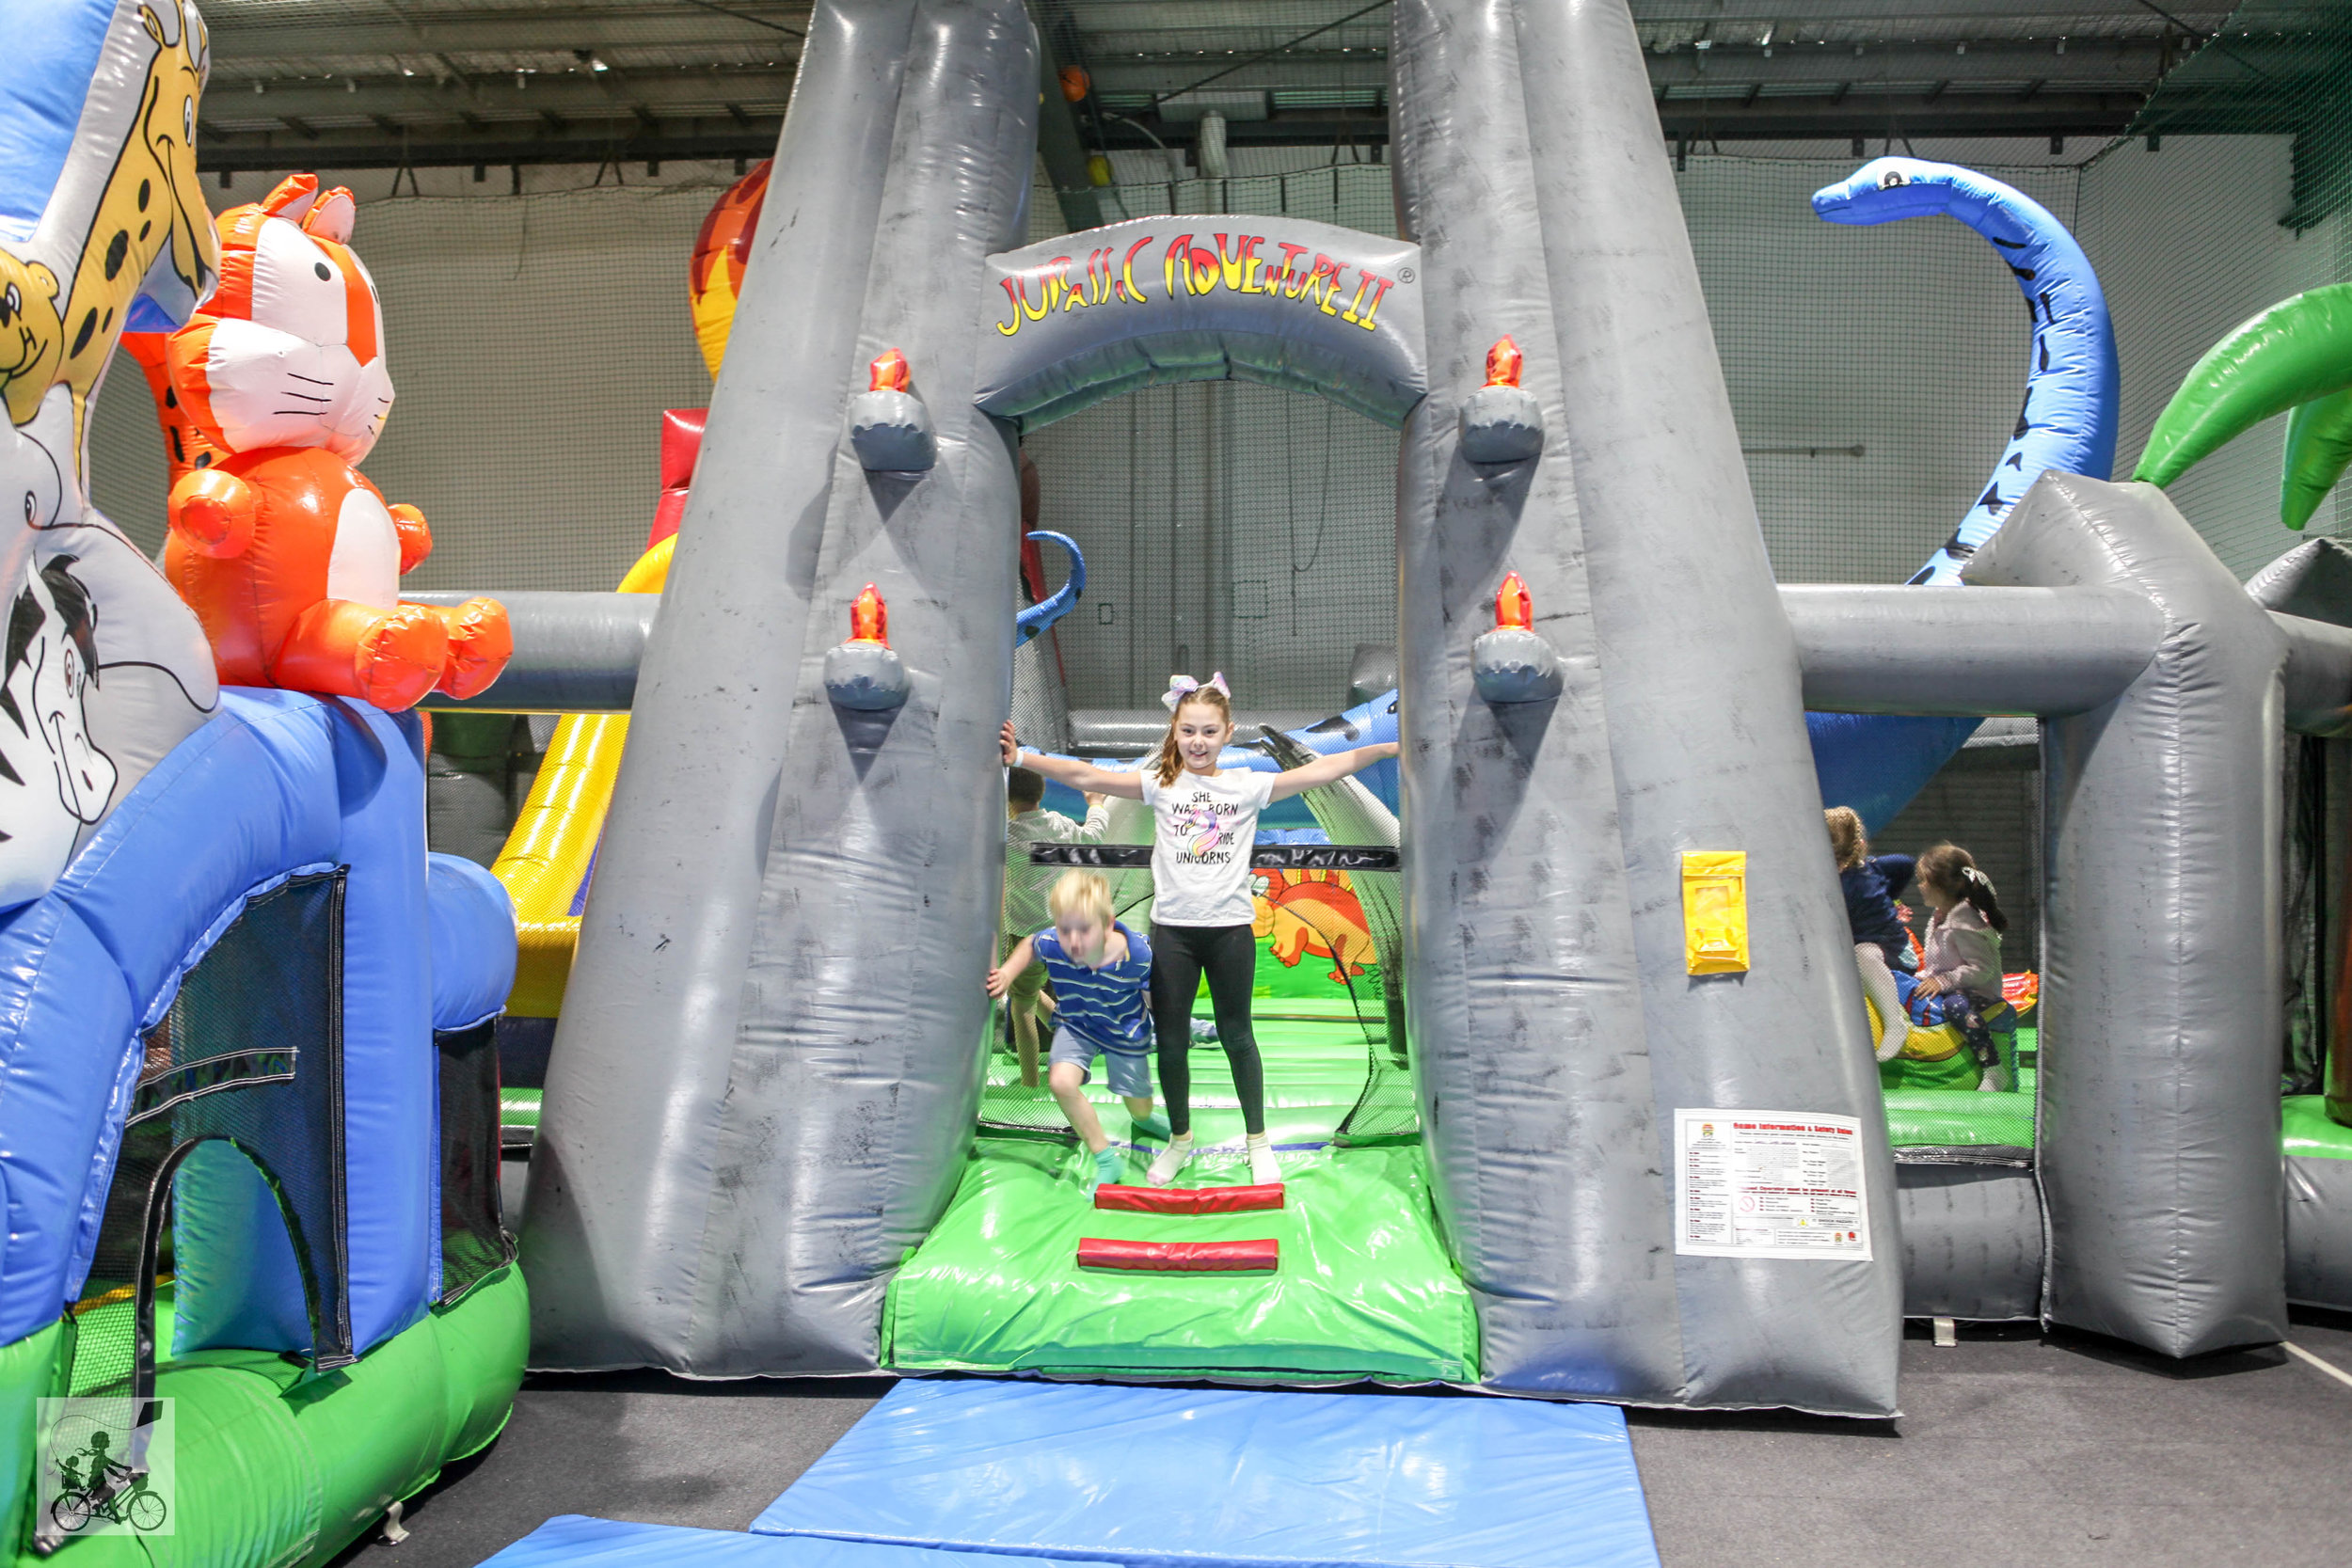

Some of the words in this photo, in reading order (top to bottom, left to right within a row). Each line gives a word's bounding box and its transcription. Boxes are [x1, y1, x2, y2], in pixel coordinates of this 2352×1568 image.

[996, 236, 1152, 337] JURASSIC
[1164, 232, 1350, 318] ADVENTURE
[1191, 791, 1212, 802] SHE
[1208, 803, 1239, 816] BORN
[1172, 824, 1188, 836] TO
[1217, 832, 1234, 845] RIDE
[1176, 851, 1231, 864] UNICORNS
